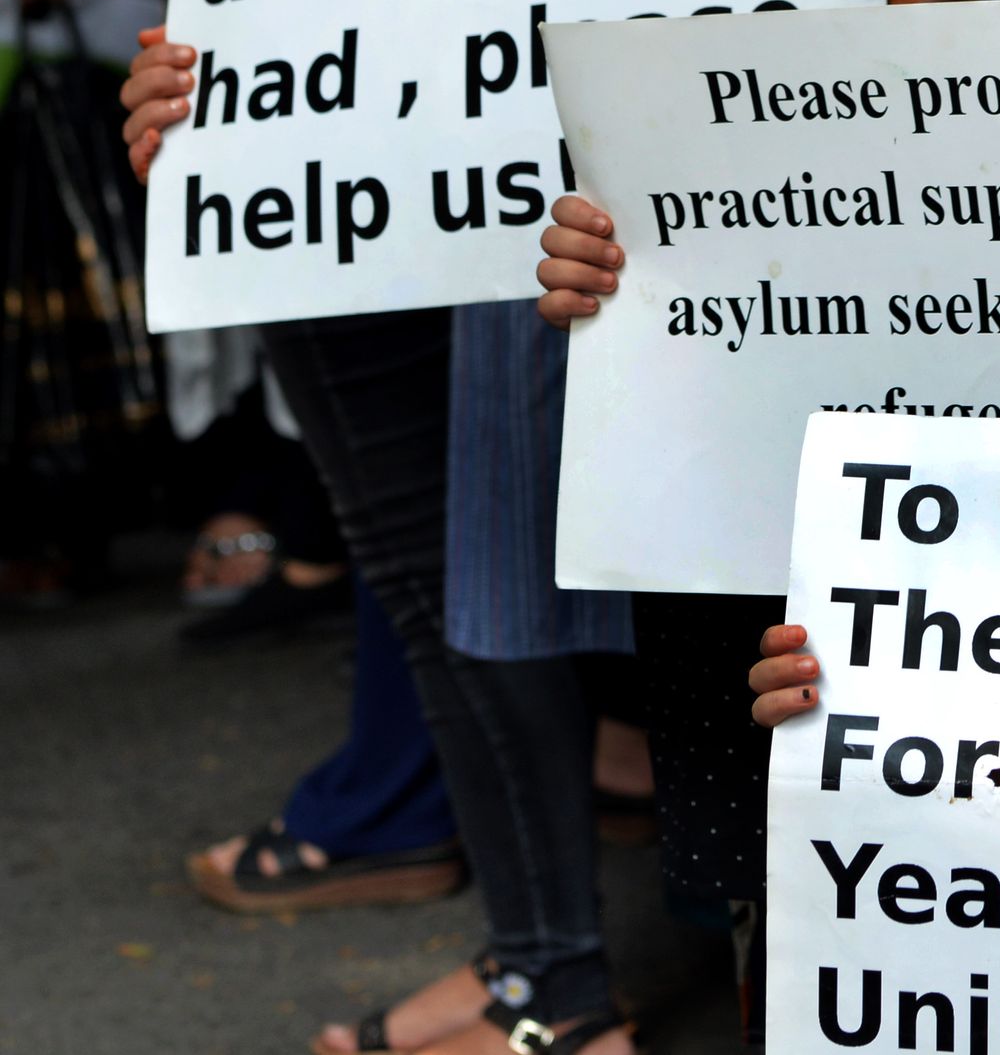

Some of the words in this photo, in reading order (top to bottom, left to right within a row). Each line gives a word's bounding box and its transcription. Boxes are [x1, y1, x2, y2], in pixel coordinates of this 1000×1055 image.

[193, 29, 358, 128] had
[700, 69, 888, 124] Please
[186, 161, 389, 264] help
[648, 171, 904, 246] practical
[668, 281, 869, 352] asylum
[843, 463, 958, 544] To
[821, 714, 1000, 800] For
